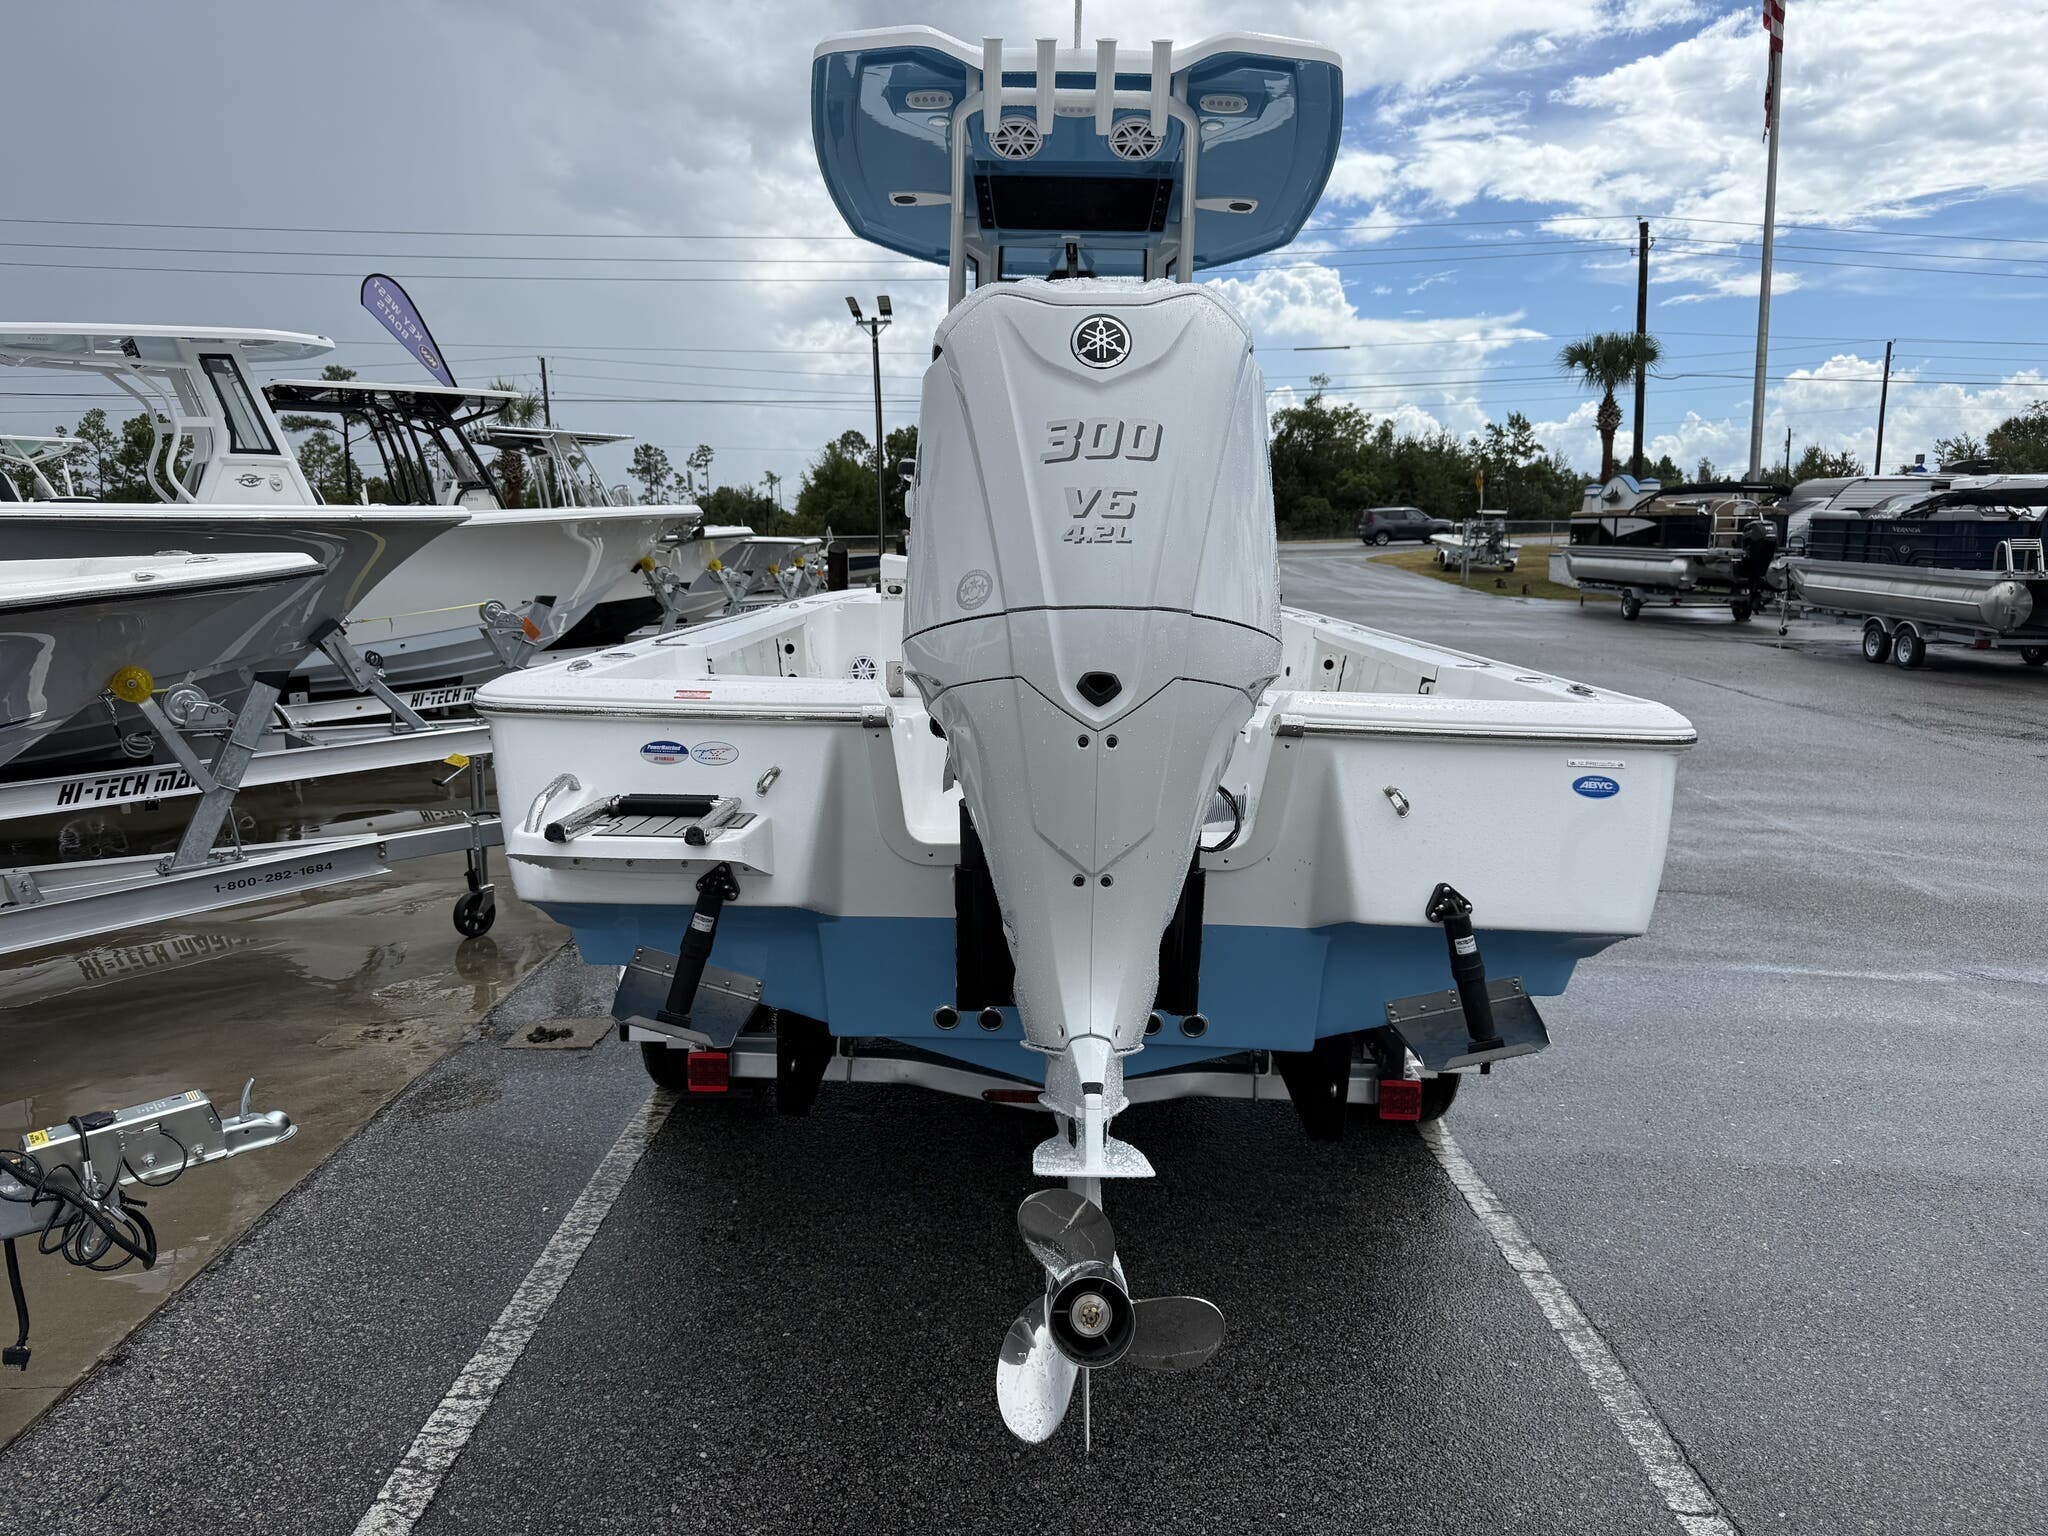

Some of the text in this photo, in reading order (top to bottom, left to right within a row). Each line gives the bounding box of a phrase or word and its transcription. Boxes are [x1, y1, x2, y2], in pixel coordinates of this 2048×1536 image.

[1040, 417, 1163, 464] 300
[1064, 487, 1138, 519] V6
[1061, 524, 1133, 544] 4.2L
[410, 688, 461, 708] HI-TECH
[57, 774, 150, 806] HI-TECH
[1579, 780, 1614, 790] ABYC
[214, 862, 333, 893] 1-800-282-1684
